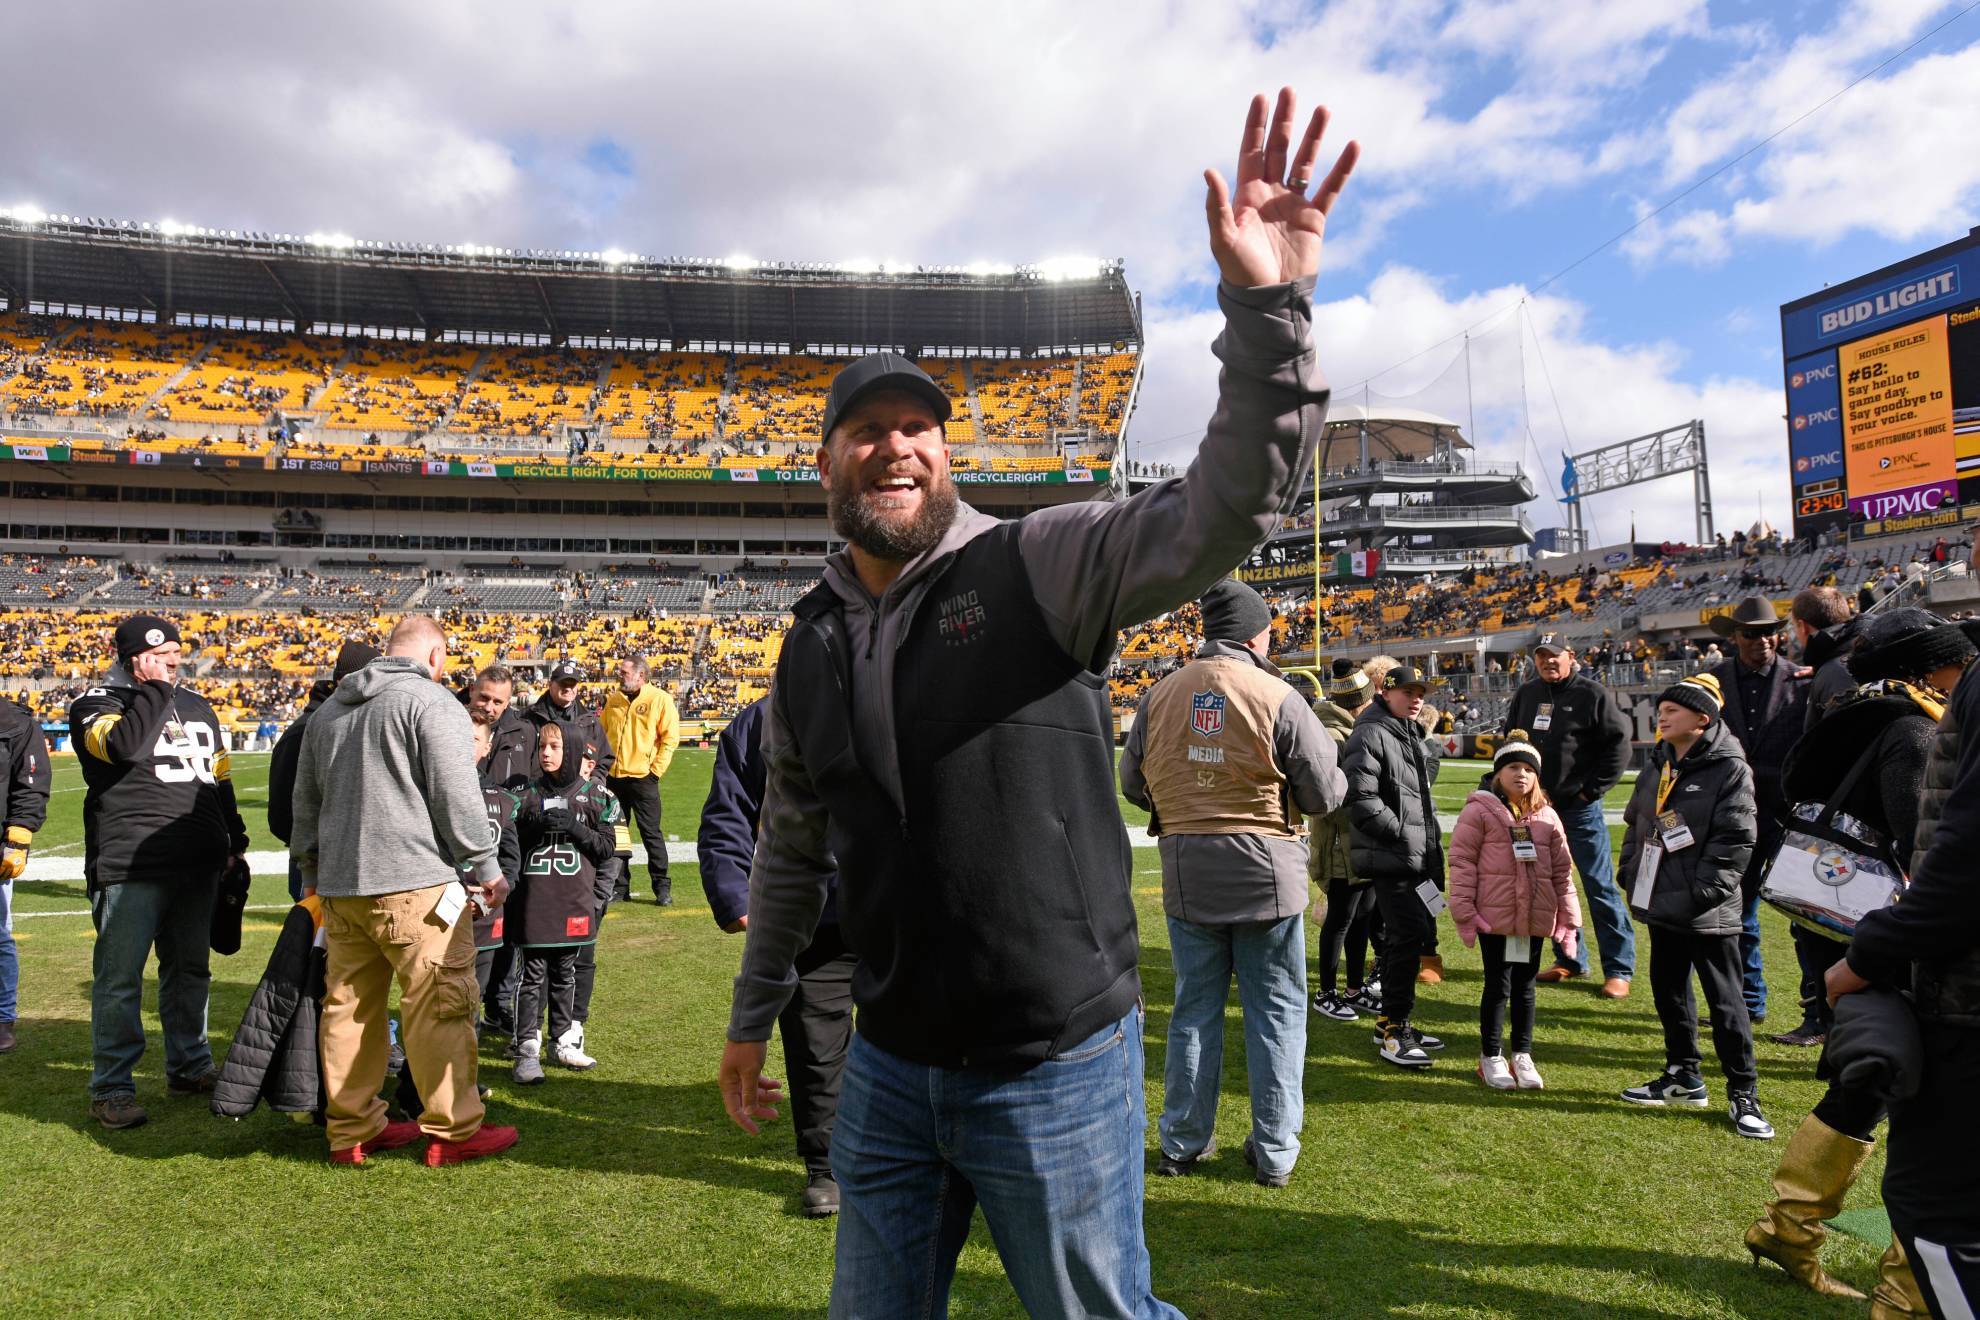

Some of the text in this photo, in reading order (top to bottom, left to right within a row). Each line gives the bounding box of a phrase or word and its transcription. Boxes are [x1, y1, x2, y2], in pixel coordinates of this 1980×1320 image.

[1822, 271, 1954, 333] BUD LIGHT
[1858, 344, 1891, 360] HOUSE
[1893, 334, 1926, 350] RULES
[1806, 364, 1835, 383] PNC
[1848, 362, 1888, 384] #62:
[1848, 370, 1920, 397] Say hello to
[1849, 386, 1909, 410] game day.
[1849, 390, 1943, 421] Say goodbye to
[1808, 408, 1838, 426] PNC
[1851, 411, 1917, 435] your voice.
[1851, 423, 1947, 452] THIS IS PITTSBURGH'S HOUSE
[18, 448, 43, 456] WM
[72, 449, 116, 463] Steelers
[1811, 451, 1840, 469] PNC
[1893, 452, 1919, 466] PNC
[224, 458, 240, 468] ON
[282, 458, 339, 471] 1ST 23:40
[370, 462, 413, 473] SAINTS
[471, 466, 493, 474] WM
[513, 465, 713, 480] RECYCLE RIGHT, FOR TOMORROW
[734, 471, 755, 479] WM
[775, 470, 790, 480] TO
[1801, 493, 1843, 515] 23:40
[1862, 488, 1942, 520] UPMC
[1884, 511, 1958, 533] Steelers.com
[940, 590, 979, 616] WIND
[938, 605, 986, 635] RIVER
[1413, 668, 1423, 680] P
[1194, 709, 1221, 731] NFL
[1187, 744, 1225, 763] MEDIA
[1197, 770, 1216, 788] 52
